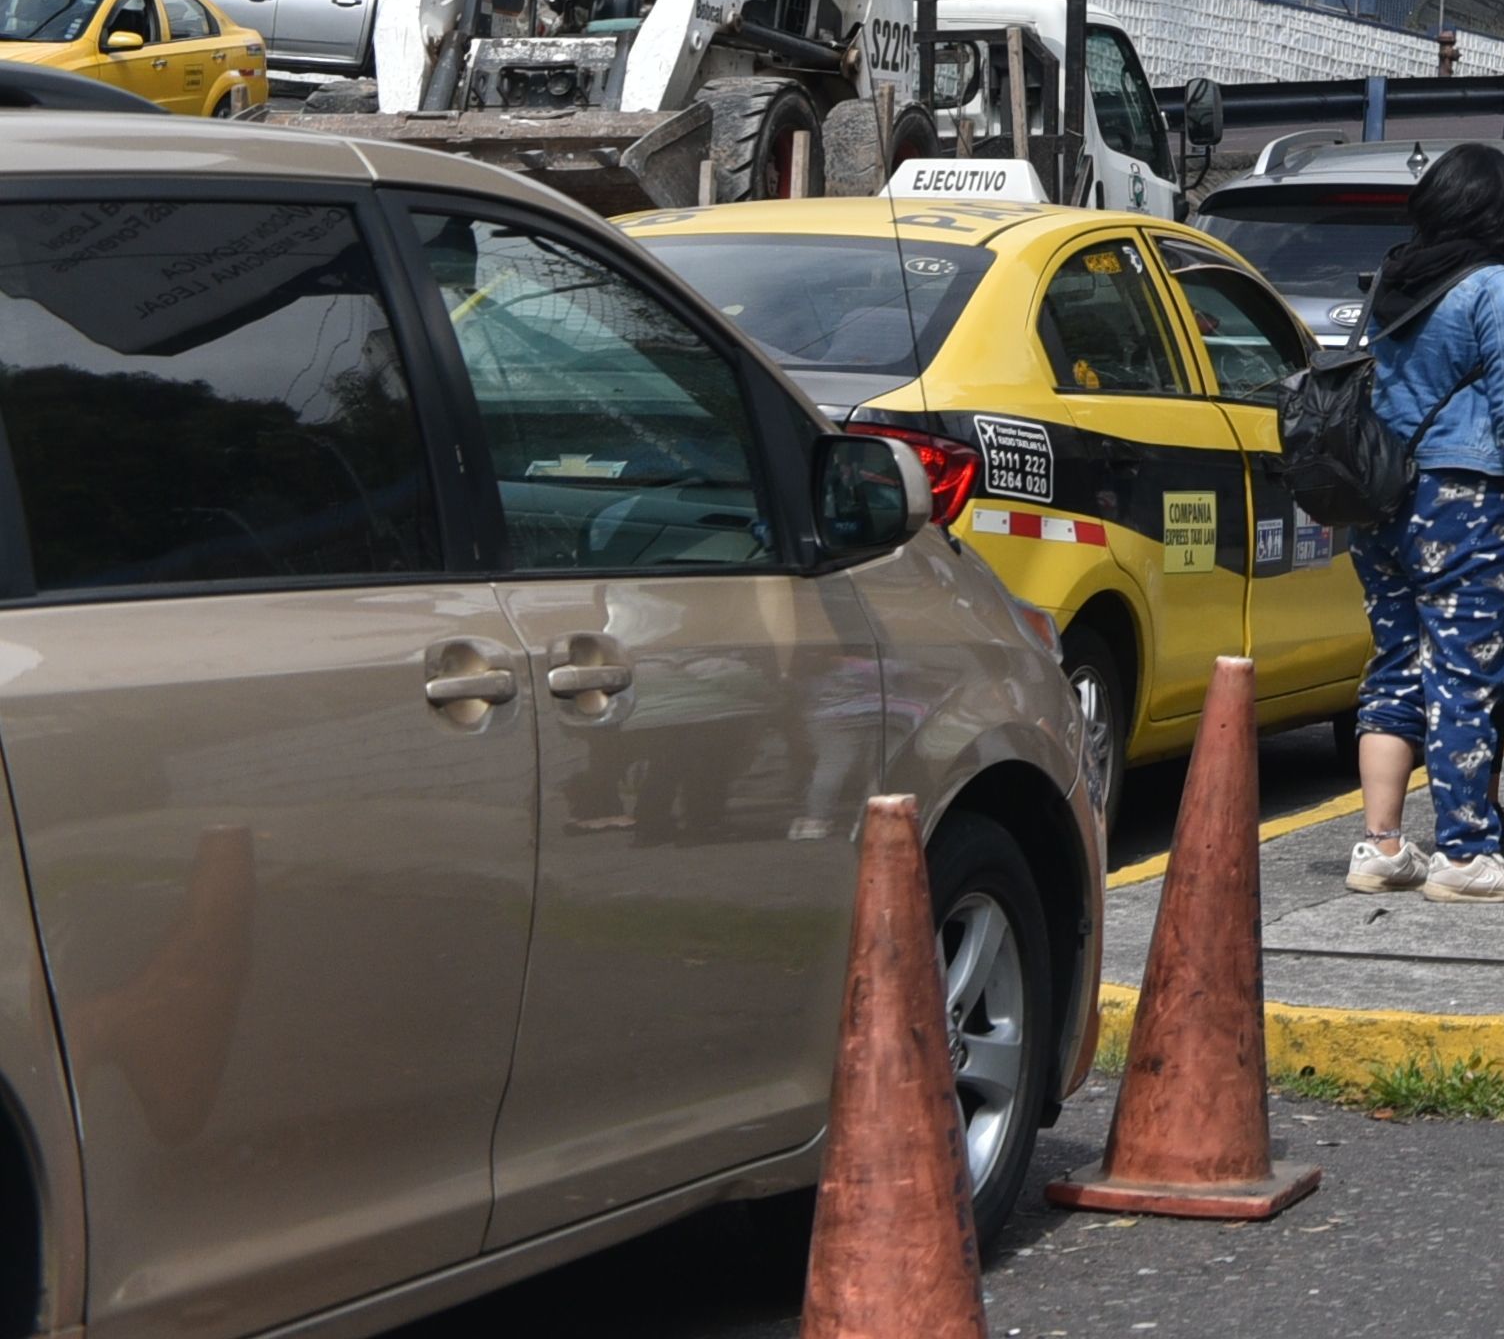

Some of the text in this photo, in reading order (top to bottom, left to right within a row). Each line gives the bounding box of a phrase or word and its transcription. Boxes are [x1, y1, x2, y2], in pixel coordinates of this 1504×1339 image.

[912, 169, 1007, 192] EJECUTIVO
[990, 449, 1046, 475] 5111 222
[991, 468, 1047, 494] 3264 020
